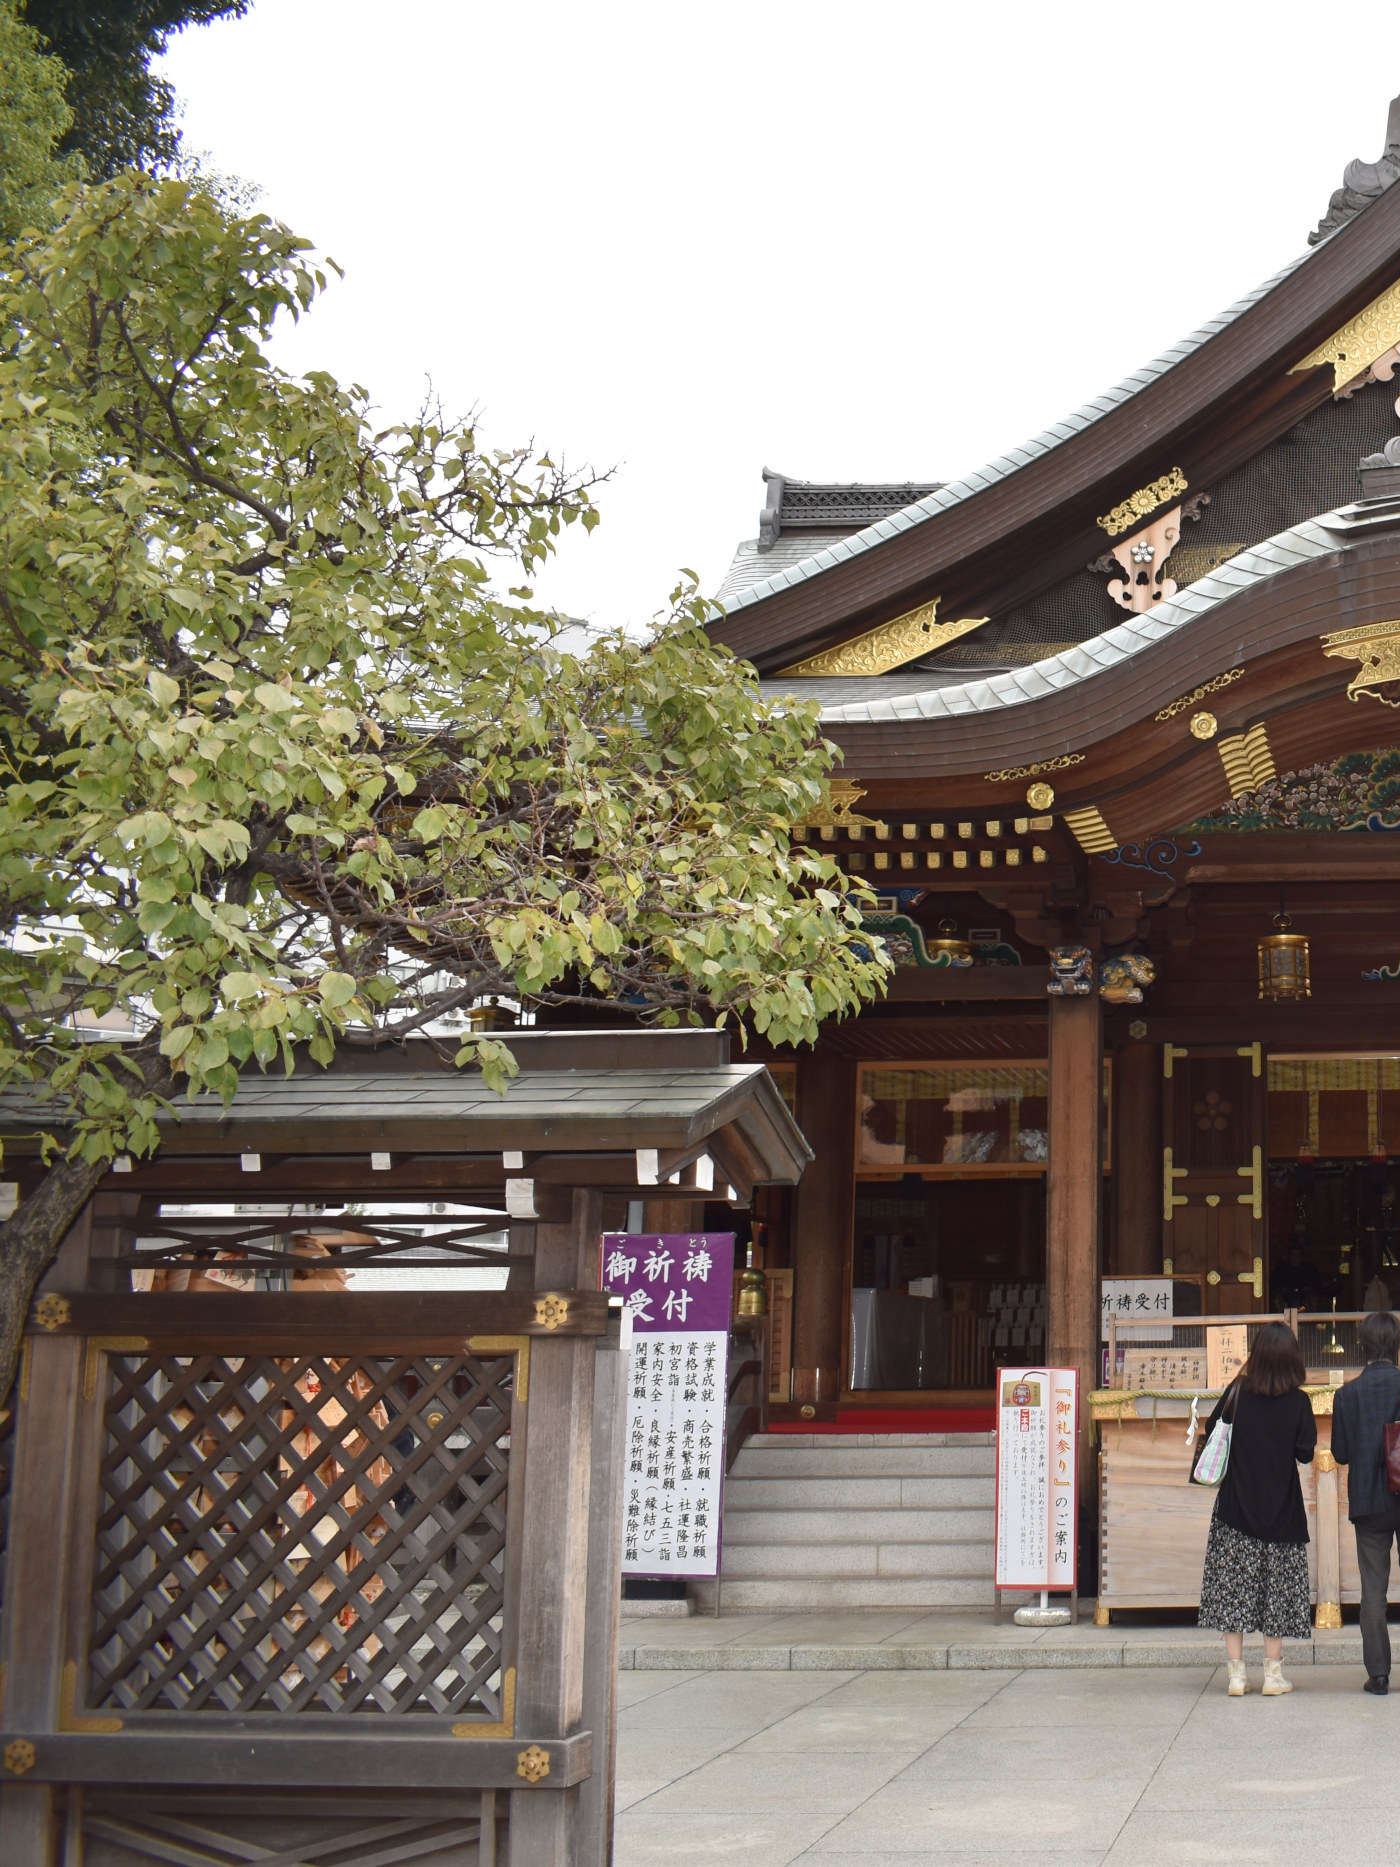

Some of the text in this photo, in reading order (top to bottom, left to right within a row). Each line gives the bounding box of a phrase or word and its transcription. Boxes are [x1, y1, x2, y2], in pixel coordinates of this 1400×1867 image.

[617, 1237, 707, 1249] ご き とう
[605, 1250, 713, 1285] 御祈祷
[625, 1288, 694, 1323] 受付
